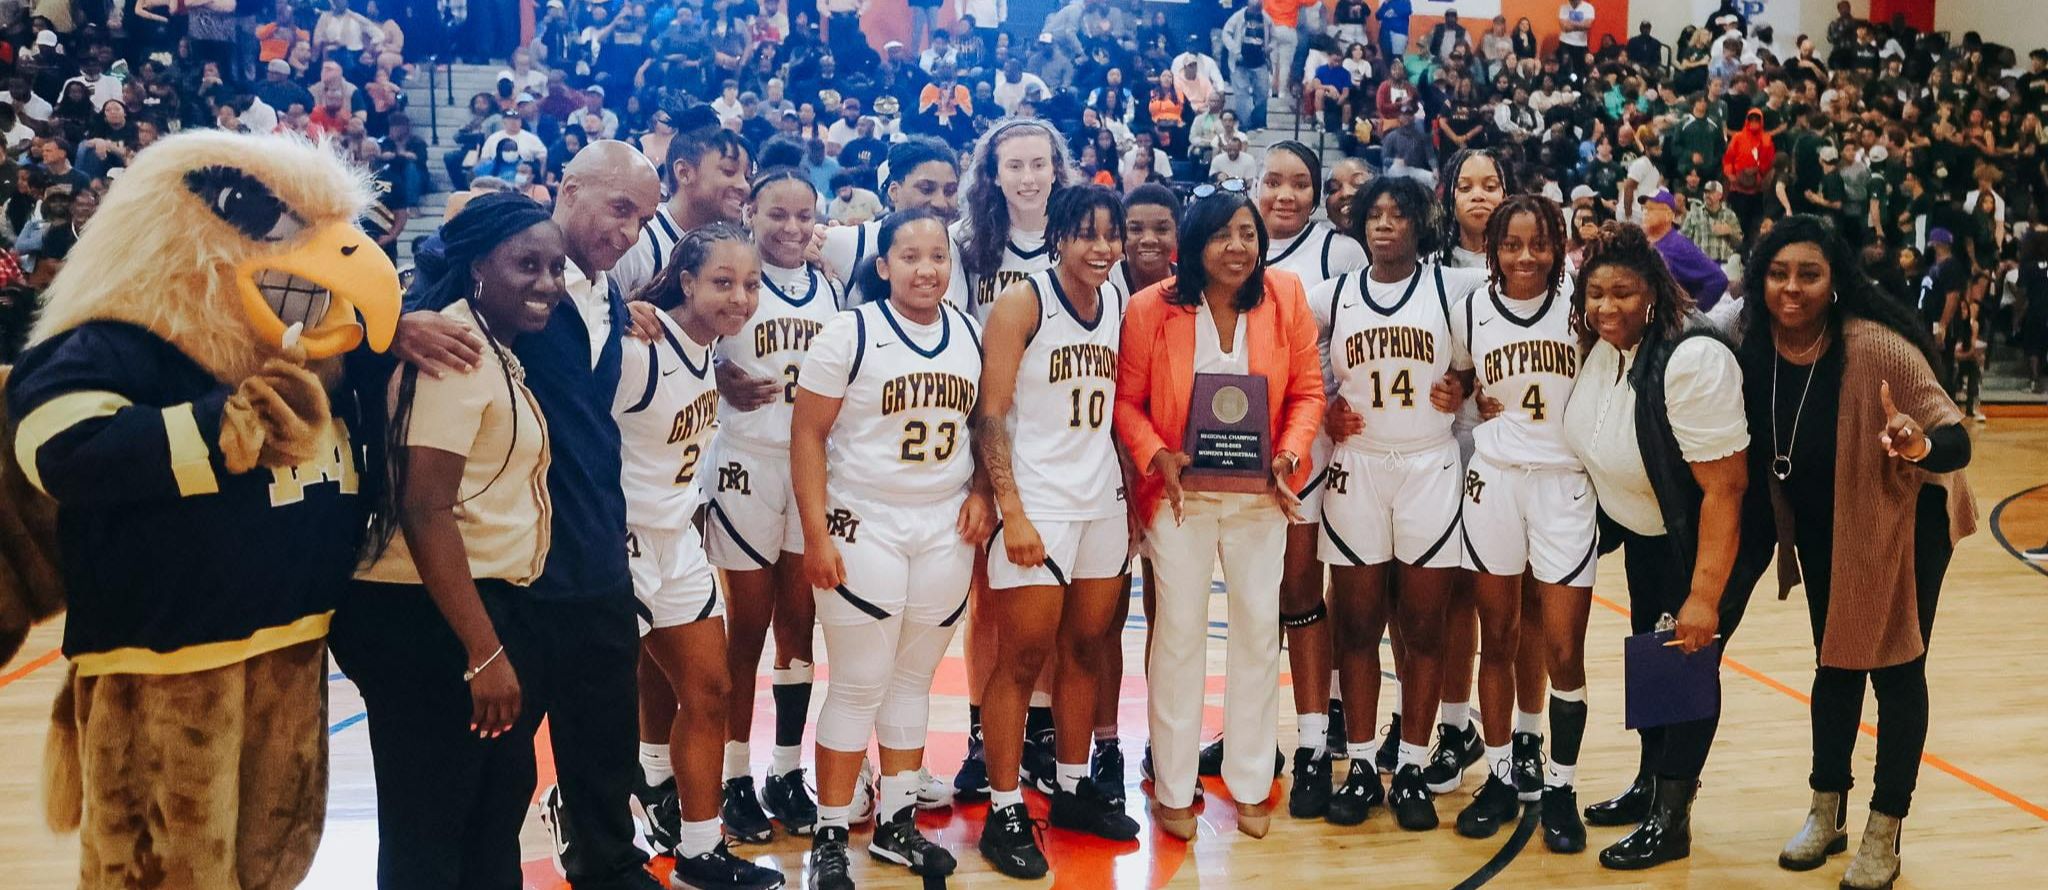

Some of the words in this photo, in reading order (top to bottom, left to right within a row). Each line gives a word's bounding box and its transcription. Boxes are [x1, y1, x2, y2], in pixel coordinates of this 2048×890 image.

[754, 317, 823, 359] GRYPH
[1344, 326, 1435, 370] GRYPHONS
[783, 363, 801, 404] 2
[1048, 343, 1118, 384] GRYPHON
[1484, 339, 1576, 386] GRYPHONS
[881, 371, 976, 417] GRYPHONS
[1069, 387, 1106, 430] 10
[1370, 368, 1415, 409] 14
[1520, 383, 1546, 421] 4
[900, 420, 957, 462] 23
[1228, 434, 1258, 442] CHAMPION
